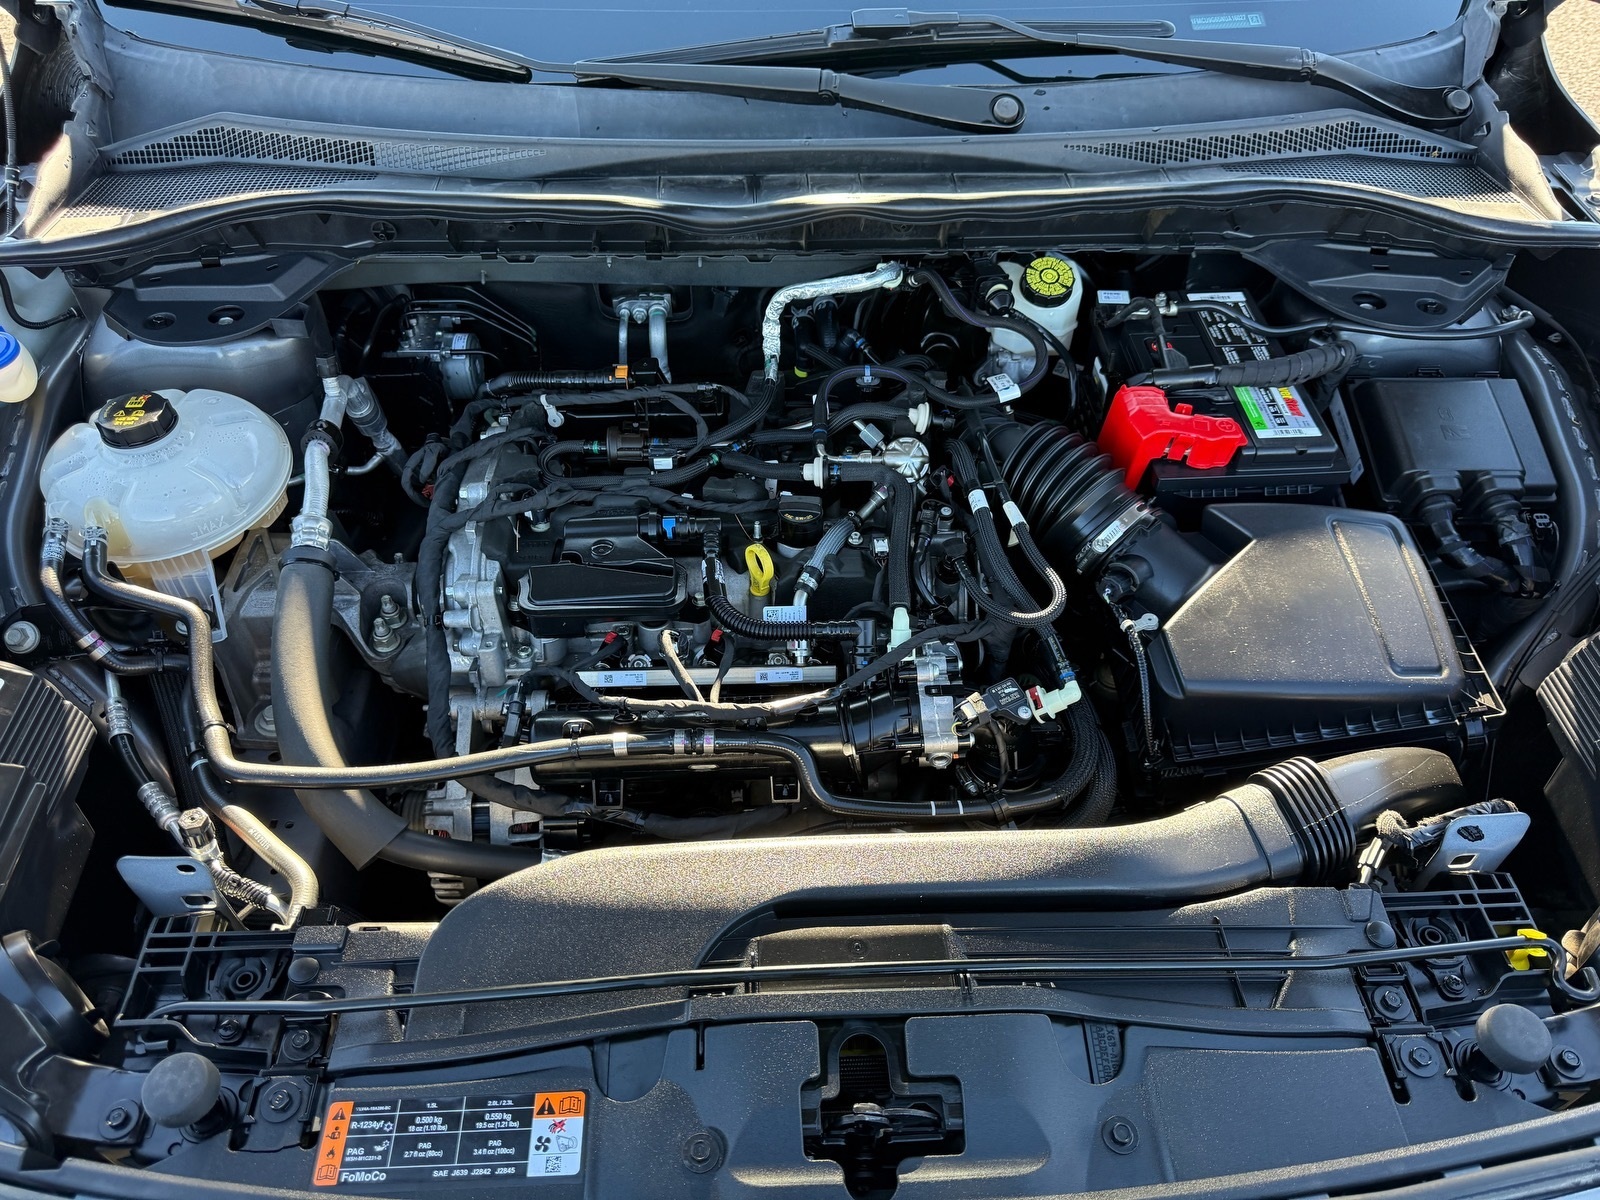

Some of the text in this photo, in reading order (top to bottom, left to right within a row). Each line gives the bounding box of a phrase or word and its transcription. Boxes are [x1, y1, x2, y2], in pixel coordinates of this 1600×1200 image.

[1278, 387, 1305, 417] verStart
[197, 515, 230, 535] MAX
[415, 1116, 443, 1125] 0.500 kg
[502, 1113, 512, 1121] kg
[350, 1120, 384, 1130] R-1234yf
[423, 1125, 437, 1133] (1.10
[437, 1124, 448, 1132] lbs)
[495, 1121, 508, 1129] (1.21
[508, 1120, 520, 1128] lbs)
[346, 1147, 365, 1156] PAG
[495, 1147, 515, 1155] (100cc)
[341, 1171, 387, 1182] FoMoCo
[432, 1169, 449, 1177] SAE
[470, 1168, 491, 1176] J2842
[494, 1167, 516, 1175] J2845
